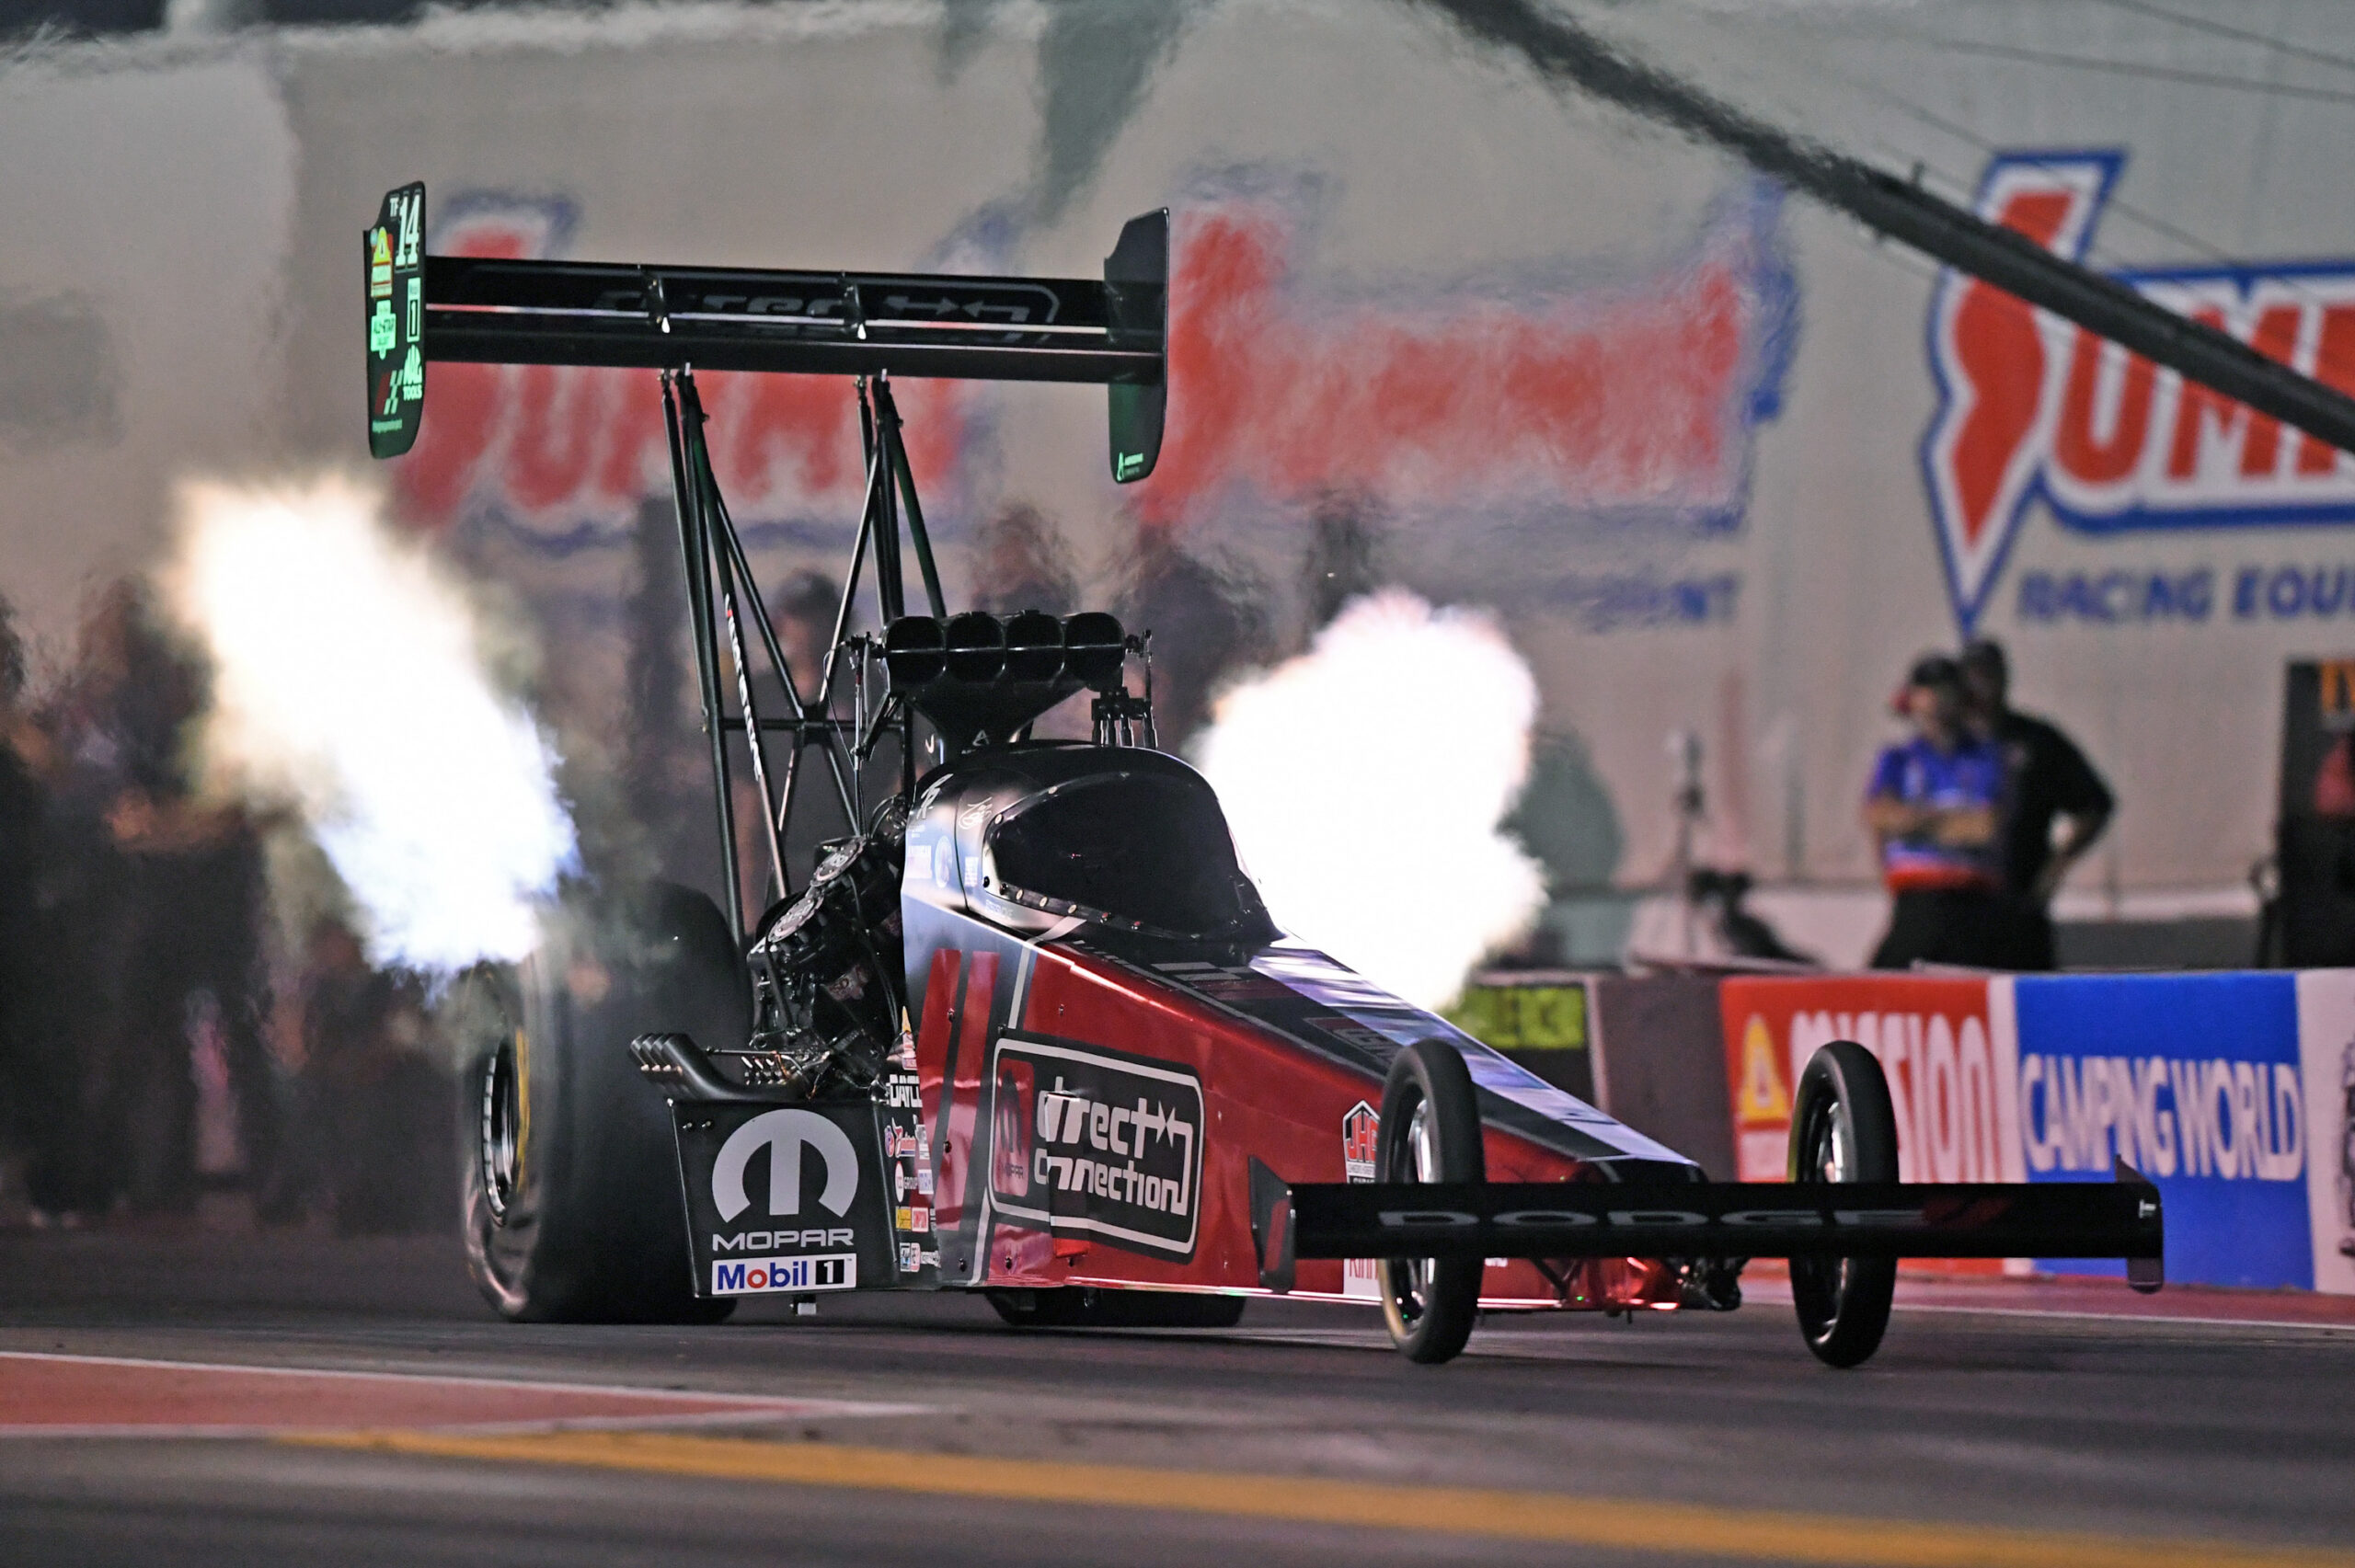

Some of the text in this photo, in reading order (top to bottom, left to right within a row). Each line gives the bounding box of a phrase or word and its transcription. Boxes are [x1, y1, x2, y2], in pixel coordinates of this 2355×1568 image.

[390, 196, 400, 217] TF
[396, 192, 420, 268] 14
[1927, 158, 2355, 598] SUM
[2234, 563, 2355, 619] EQU
[2021, 1052, 2176, 1175] CAMPING
[2172, 1058, 2303, 1181] WORLD
[712, 1228, 854, 1252] MOPAR
[718, 1260, 835, 1290] Mobil 1
